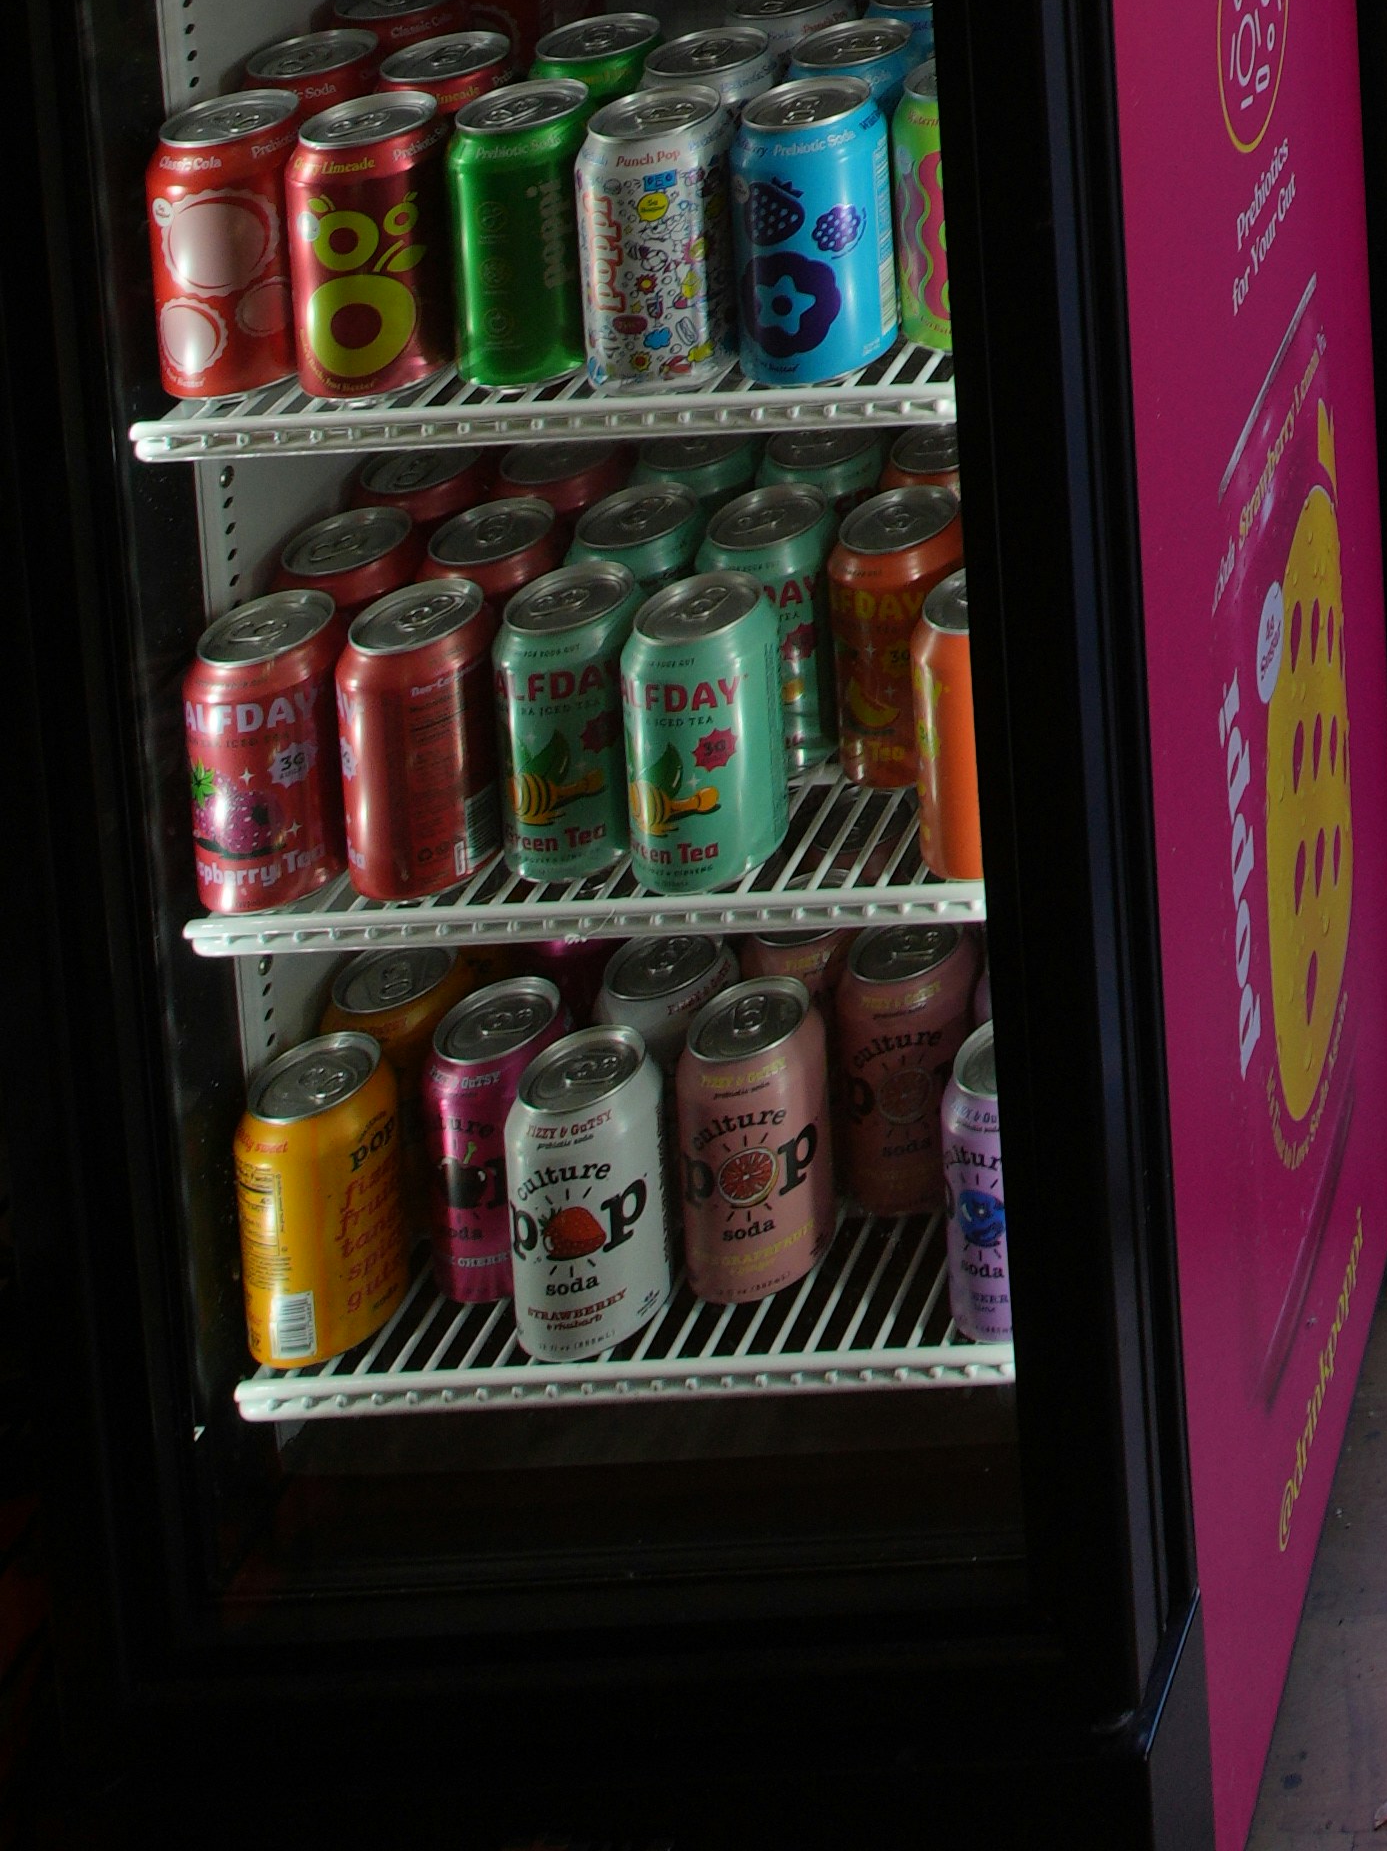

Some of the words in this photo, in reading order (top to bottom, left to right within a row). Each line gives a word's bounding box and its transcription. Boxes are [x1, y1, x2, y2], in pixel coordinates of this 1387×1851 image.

[304, 83, 338, 100] Soda
[321, 157, 376, 175] Limeade
[393, 131, 438, 161] Prebiotic
[476, 144, 528, 161] Prebiotic
[773, 138, 826, 157] Prebiotic
[827, 129, 857, 148] Soda
[193, 155, 223, 171] Cola
[615, 153, 655, 168] Punch
[656, 148, 682, 165] Pop
[1235, 136, 1291, 253] Prebiotics
[526, 178, 572, 288] poppi
[1230, 274, 1252, 317] for
[1249, 220, 1279, 277] Your
[1276, 171, 1299, 224] Gut
[1238, 395, 1298, 550] Strawberry
[688, 715, 715, 727] TEA
[280, 751, 305, 773] 3G
[564, 822, 607, 849] Tea
[283, 843, 325, 874] Tea
[676, 841, 720, 865] Tea
[1218, 665, 1262, 1081] poppi
[853, 1030, 943, 1069] culture
[570, 1109, 613, 1136] GuTSY
[694, 1106, 788, 1151] culture
[255, 1140, 289, 1154] sweet
[351, 1116, 395, 1172] pop
[881, 1134, 932, 1159] soda
[516, 1161, 612, 1202] culture
[722, 1218, 776, 1242] soda
[960, 1257, 1005, 1279] soda
[545, 1274, 600, 1297] soda
[527, 1287, 628, 1321] STRAWBERRY
[1277, 1204, 1365, 1553] @drinkpoppi
